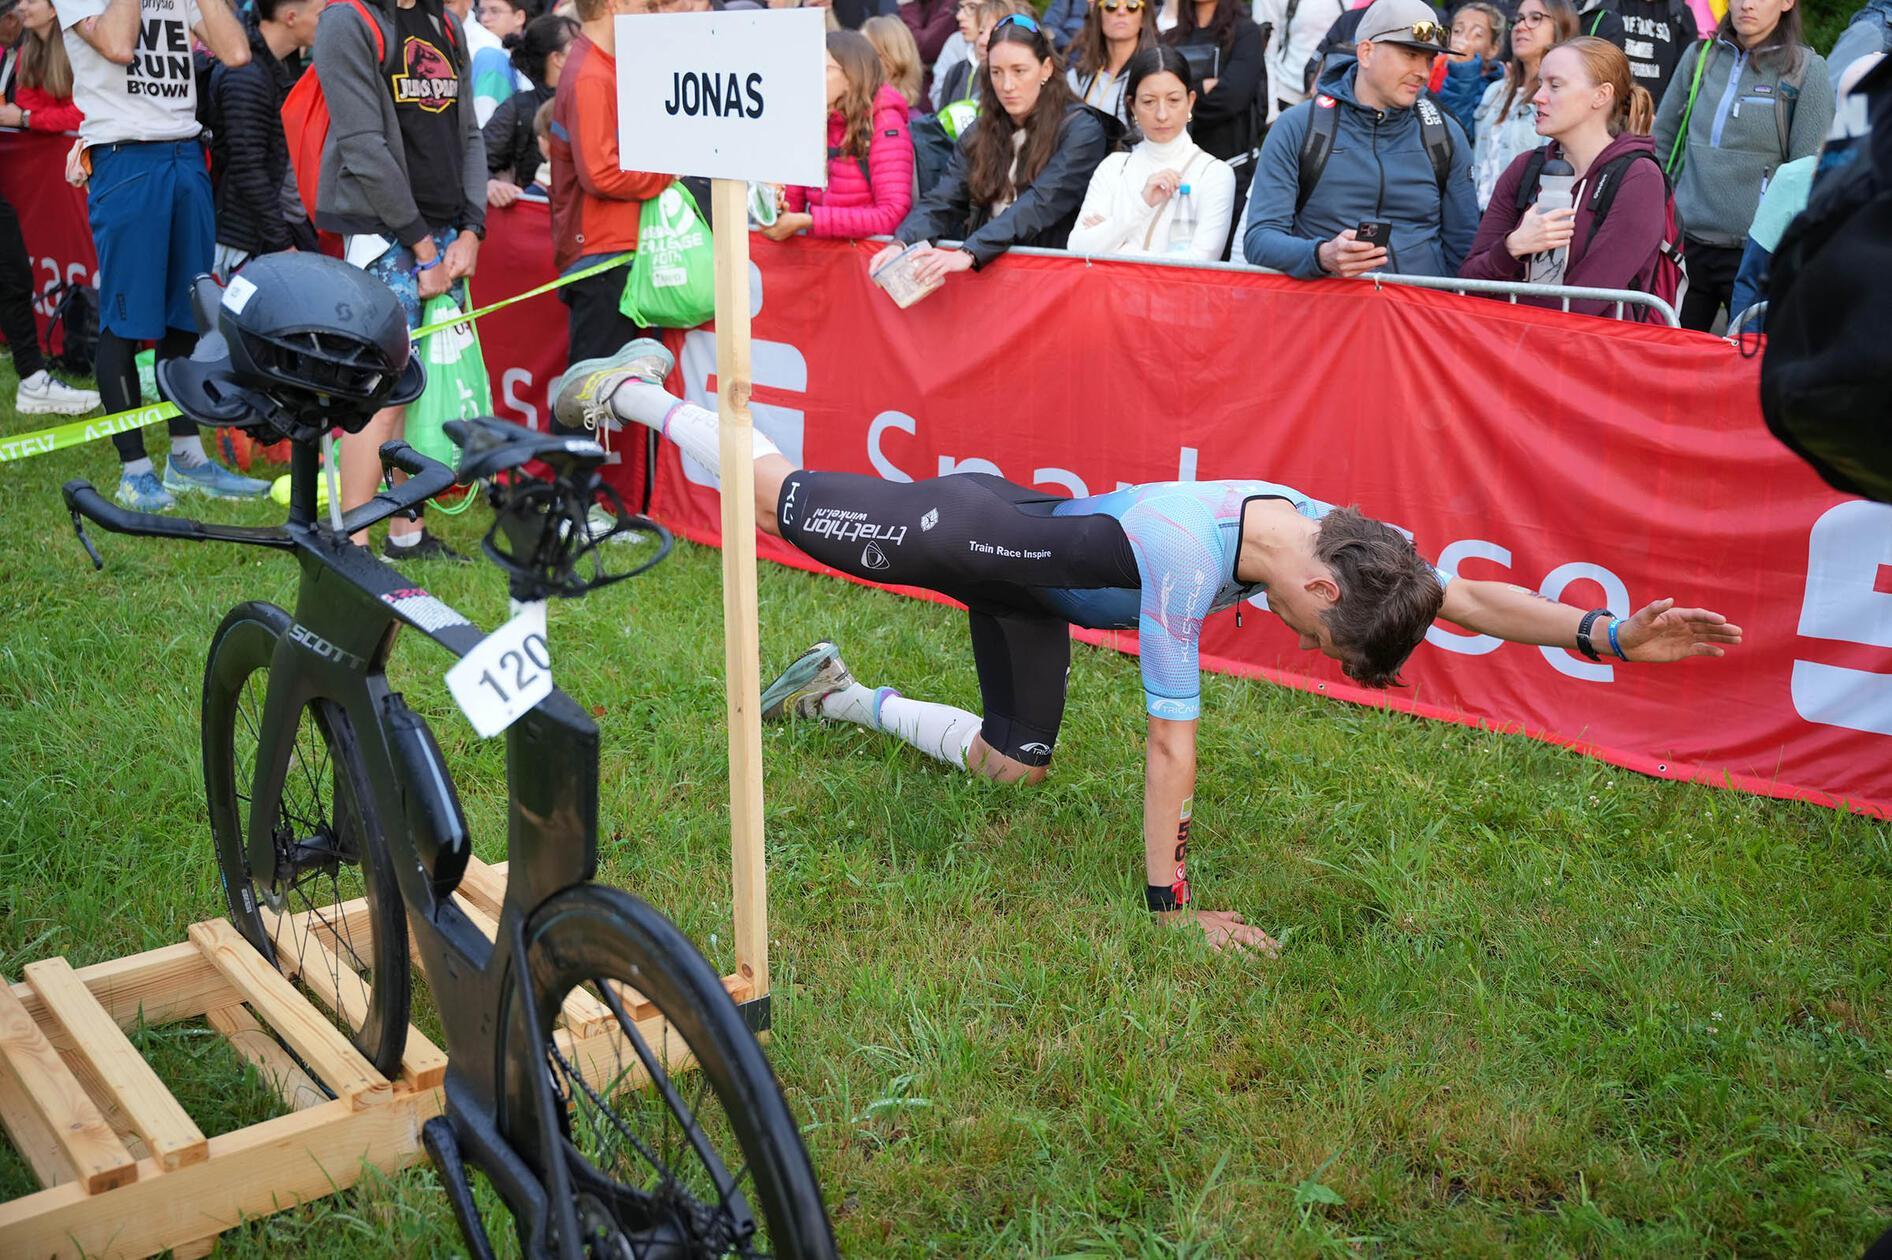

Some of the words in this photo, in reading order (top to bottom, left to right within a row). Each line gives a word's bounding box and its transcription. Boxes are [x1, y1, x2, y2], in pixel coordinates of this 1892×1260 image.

[126, 54, 190, 80] RUN
[664, 71, 764, 119] JONAS
[812, 508, 868, 522] winkel.nl
[802, 517, 908, 546] triathlon
[969, 540, 994, 554] Train
[996, 545, 1021, 558] Race
[1023, 549, 1052, 560] Inspire
[289, 623, 366, 670] SCOTT
[479, 633, 551, 703] 120
